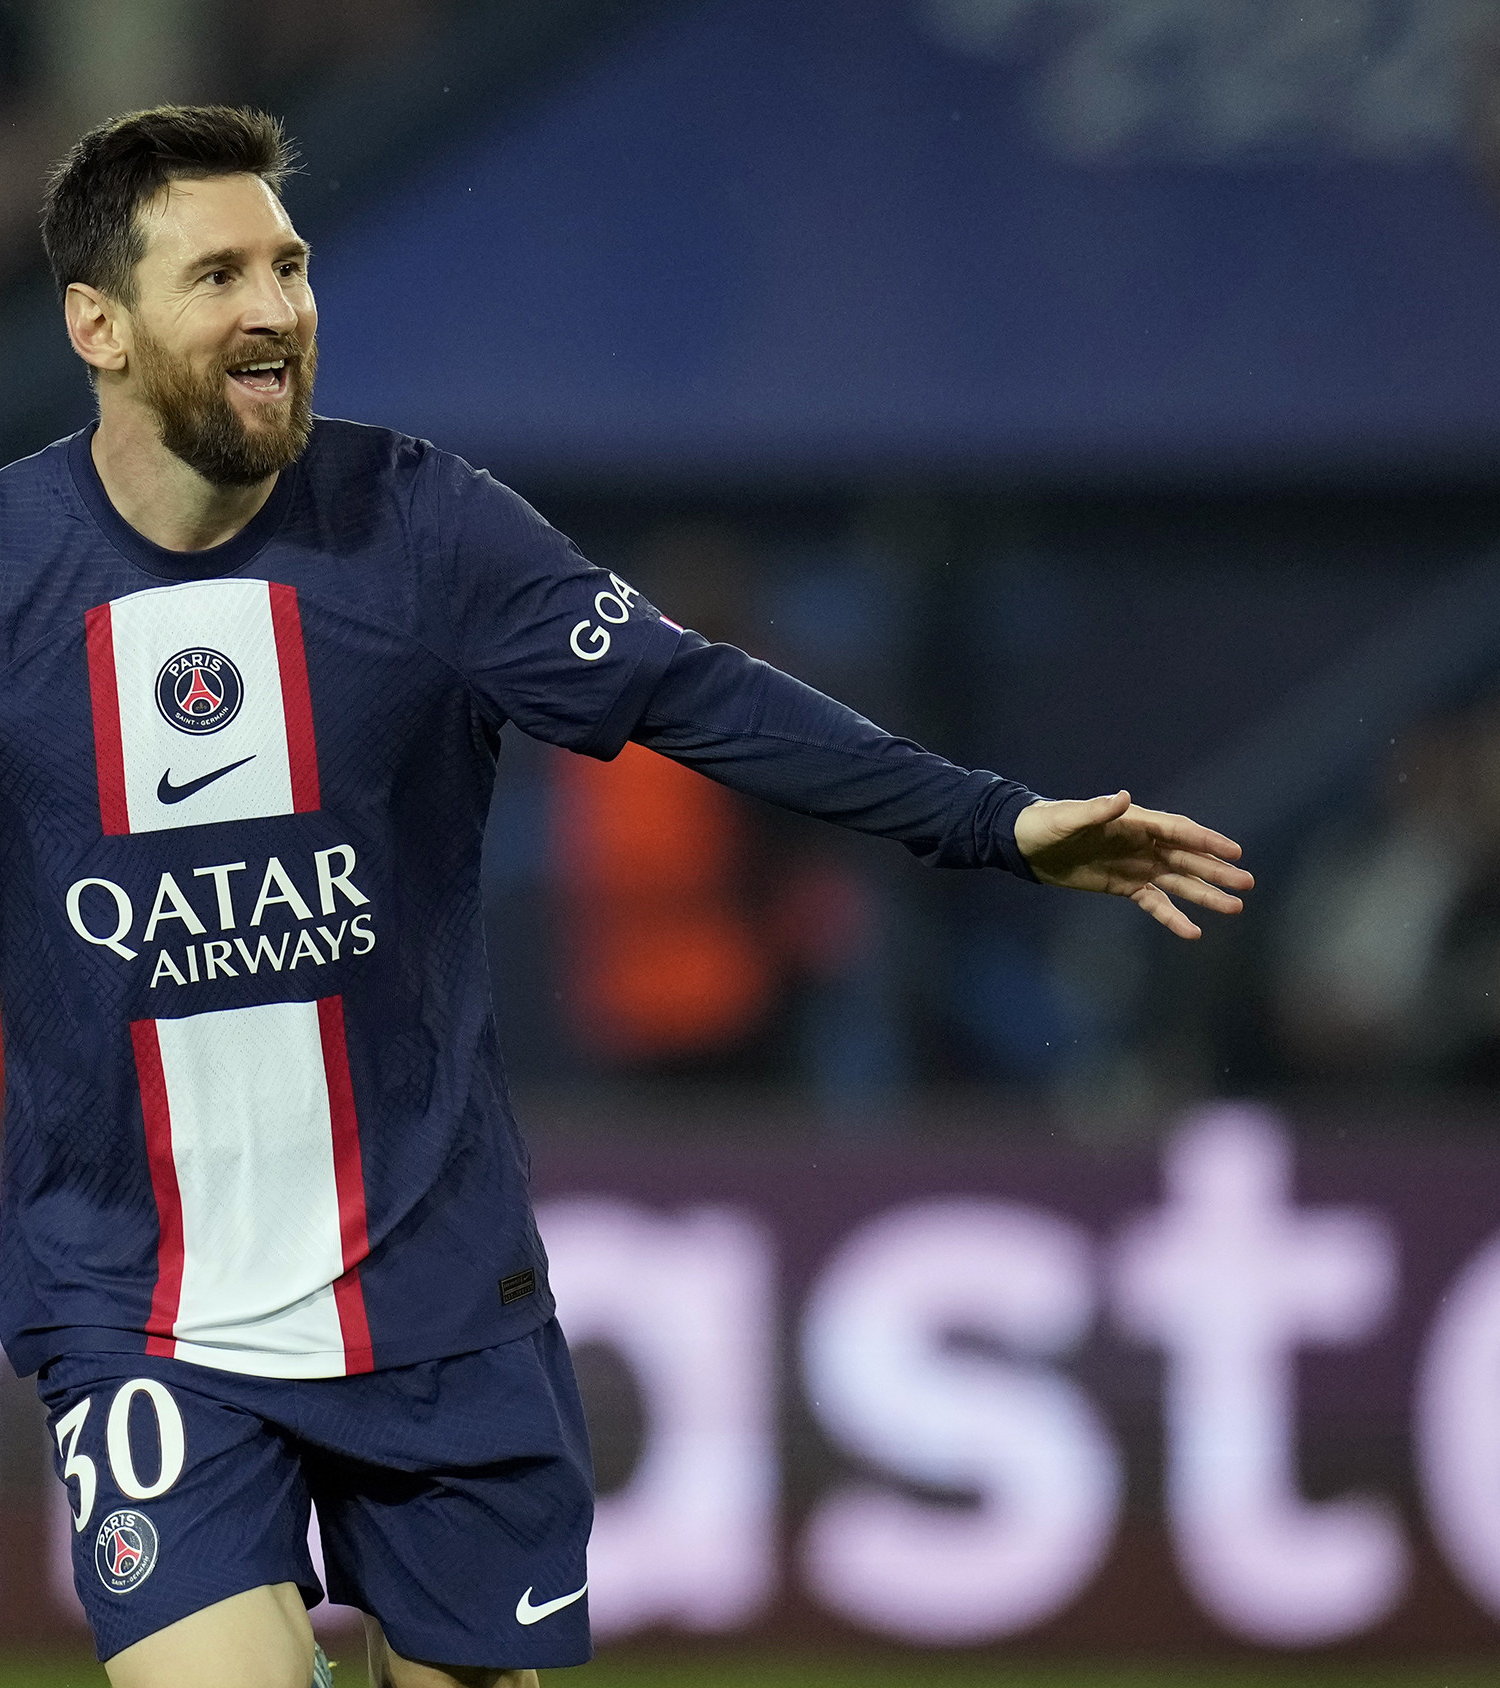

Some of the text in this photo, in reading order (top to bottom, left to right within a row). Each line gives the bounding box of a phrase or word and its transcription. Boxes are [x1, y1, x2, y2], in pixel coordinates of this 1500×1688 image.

[167, 653, 223, 677] PARIS
[65, 844, 370, 961] QATAR
[150, 913, 376, 988] AIRWAYS
[55, 1378, 185, 1533] 30
[98, 1514, 136, 1547] PARIS
